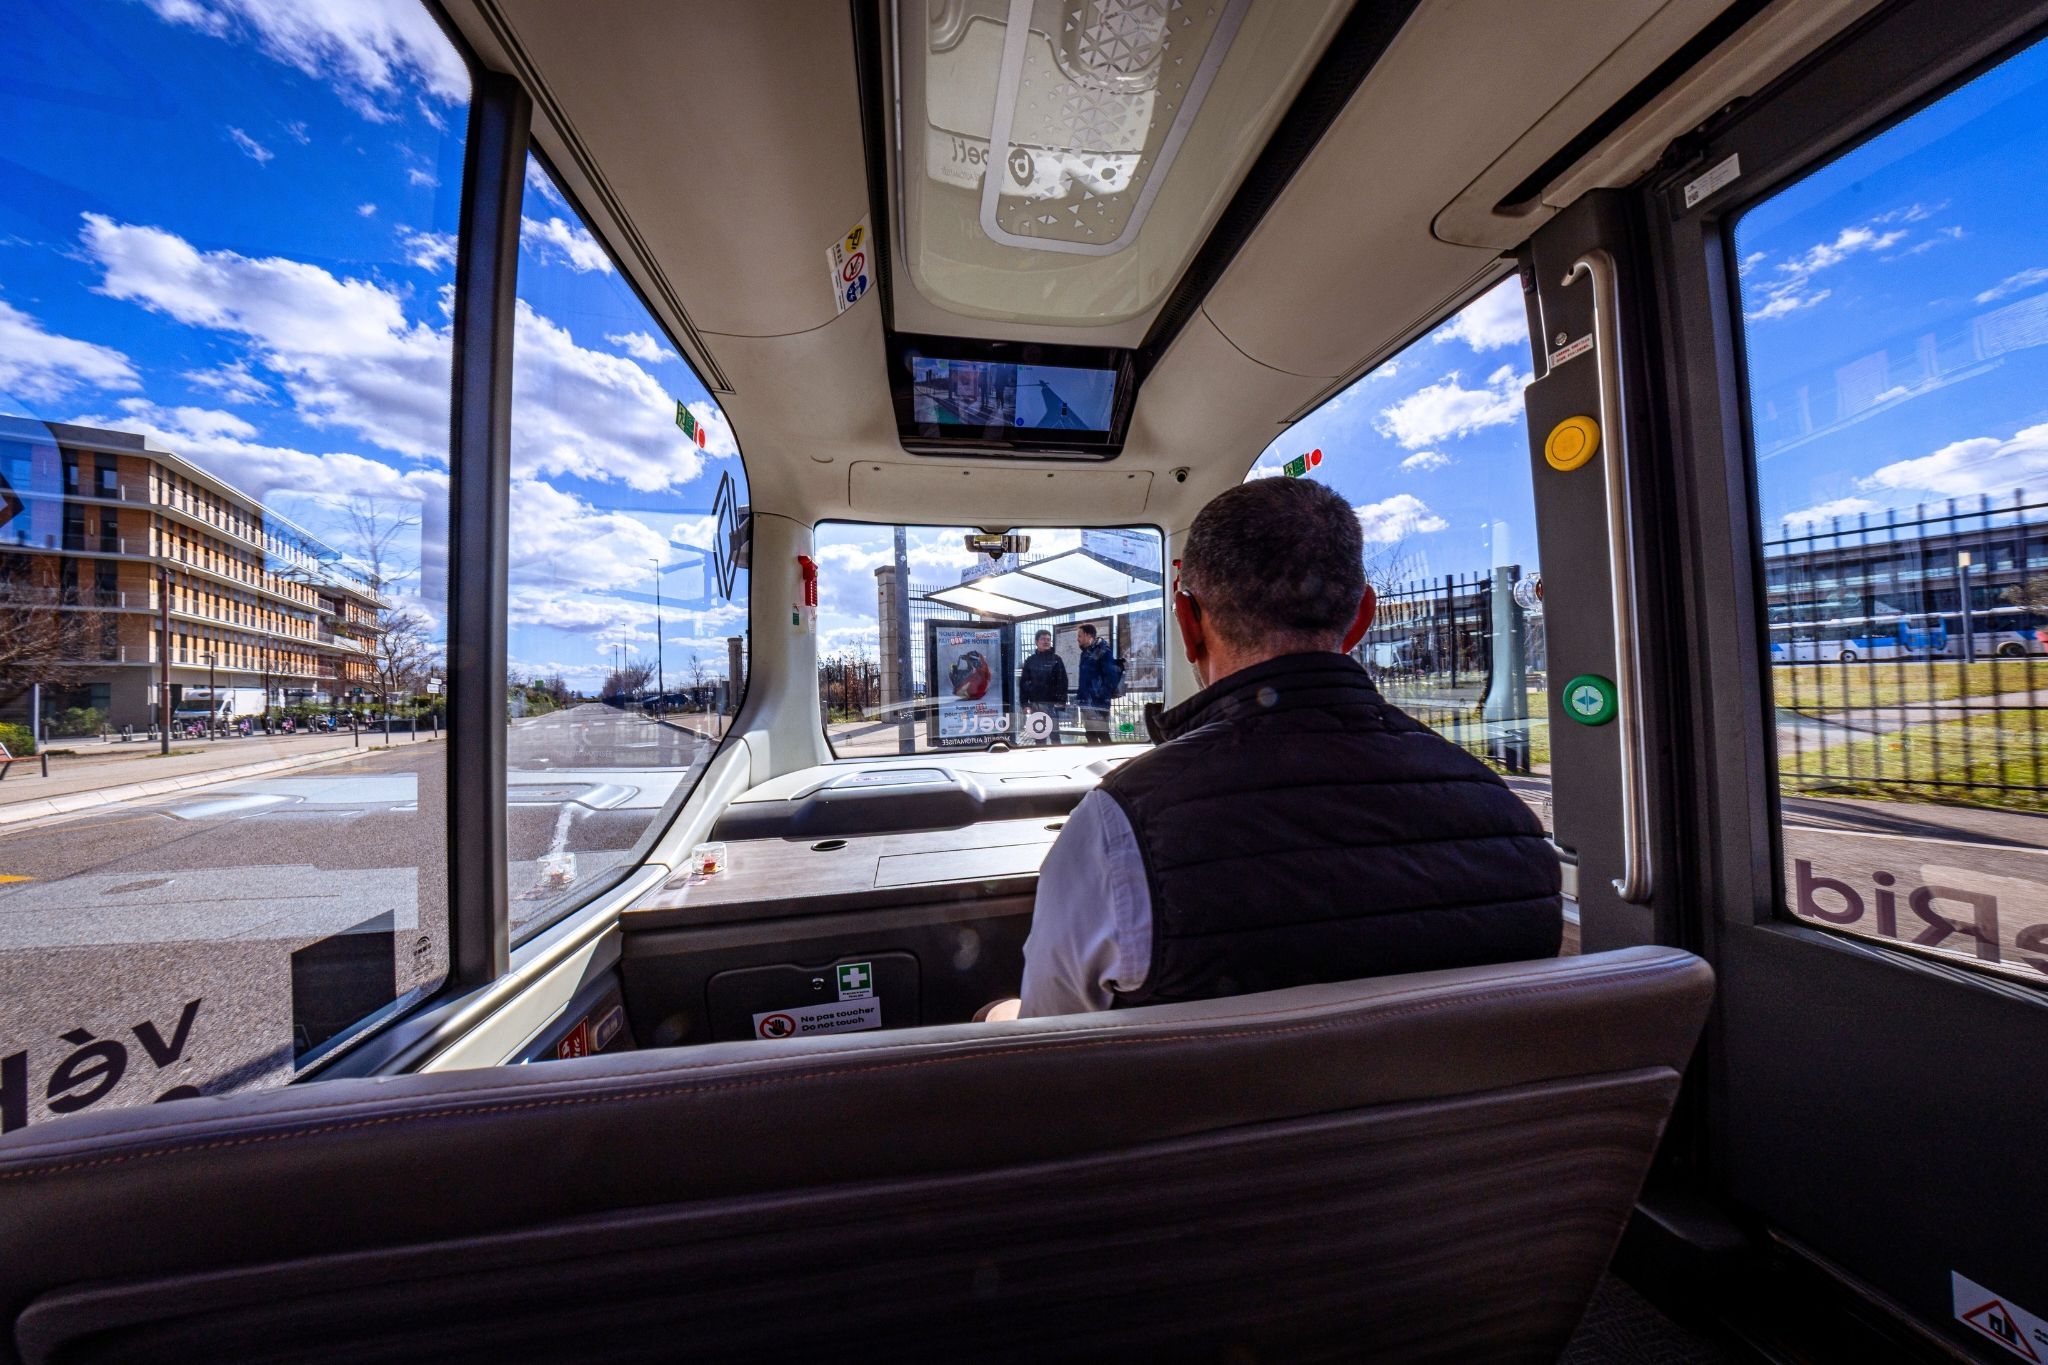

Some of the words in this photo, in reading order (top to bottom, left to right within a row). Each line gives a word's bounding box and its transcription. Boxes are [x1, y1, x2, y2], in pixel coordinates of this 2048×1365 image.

[801, 1015, 815, 1023] Ne
[816, 1013, 835, 1022] pas
[836, 1007, 875, 1017] toucher
[802, 1024, 816, 1032] Do
[817, 1021, 834, 1029] not
[836, 1017, 864, 1026] touch
